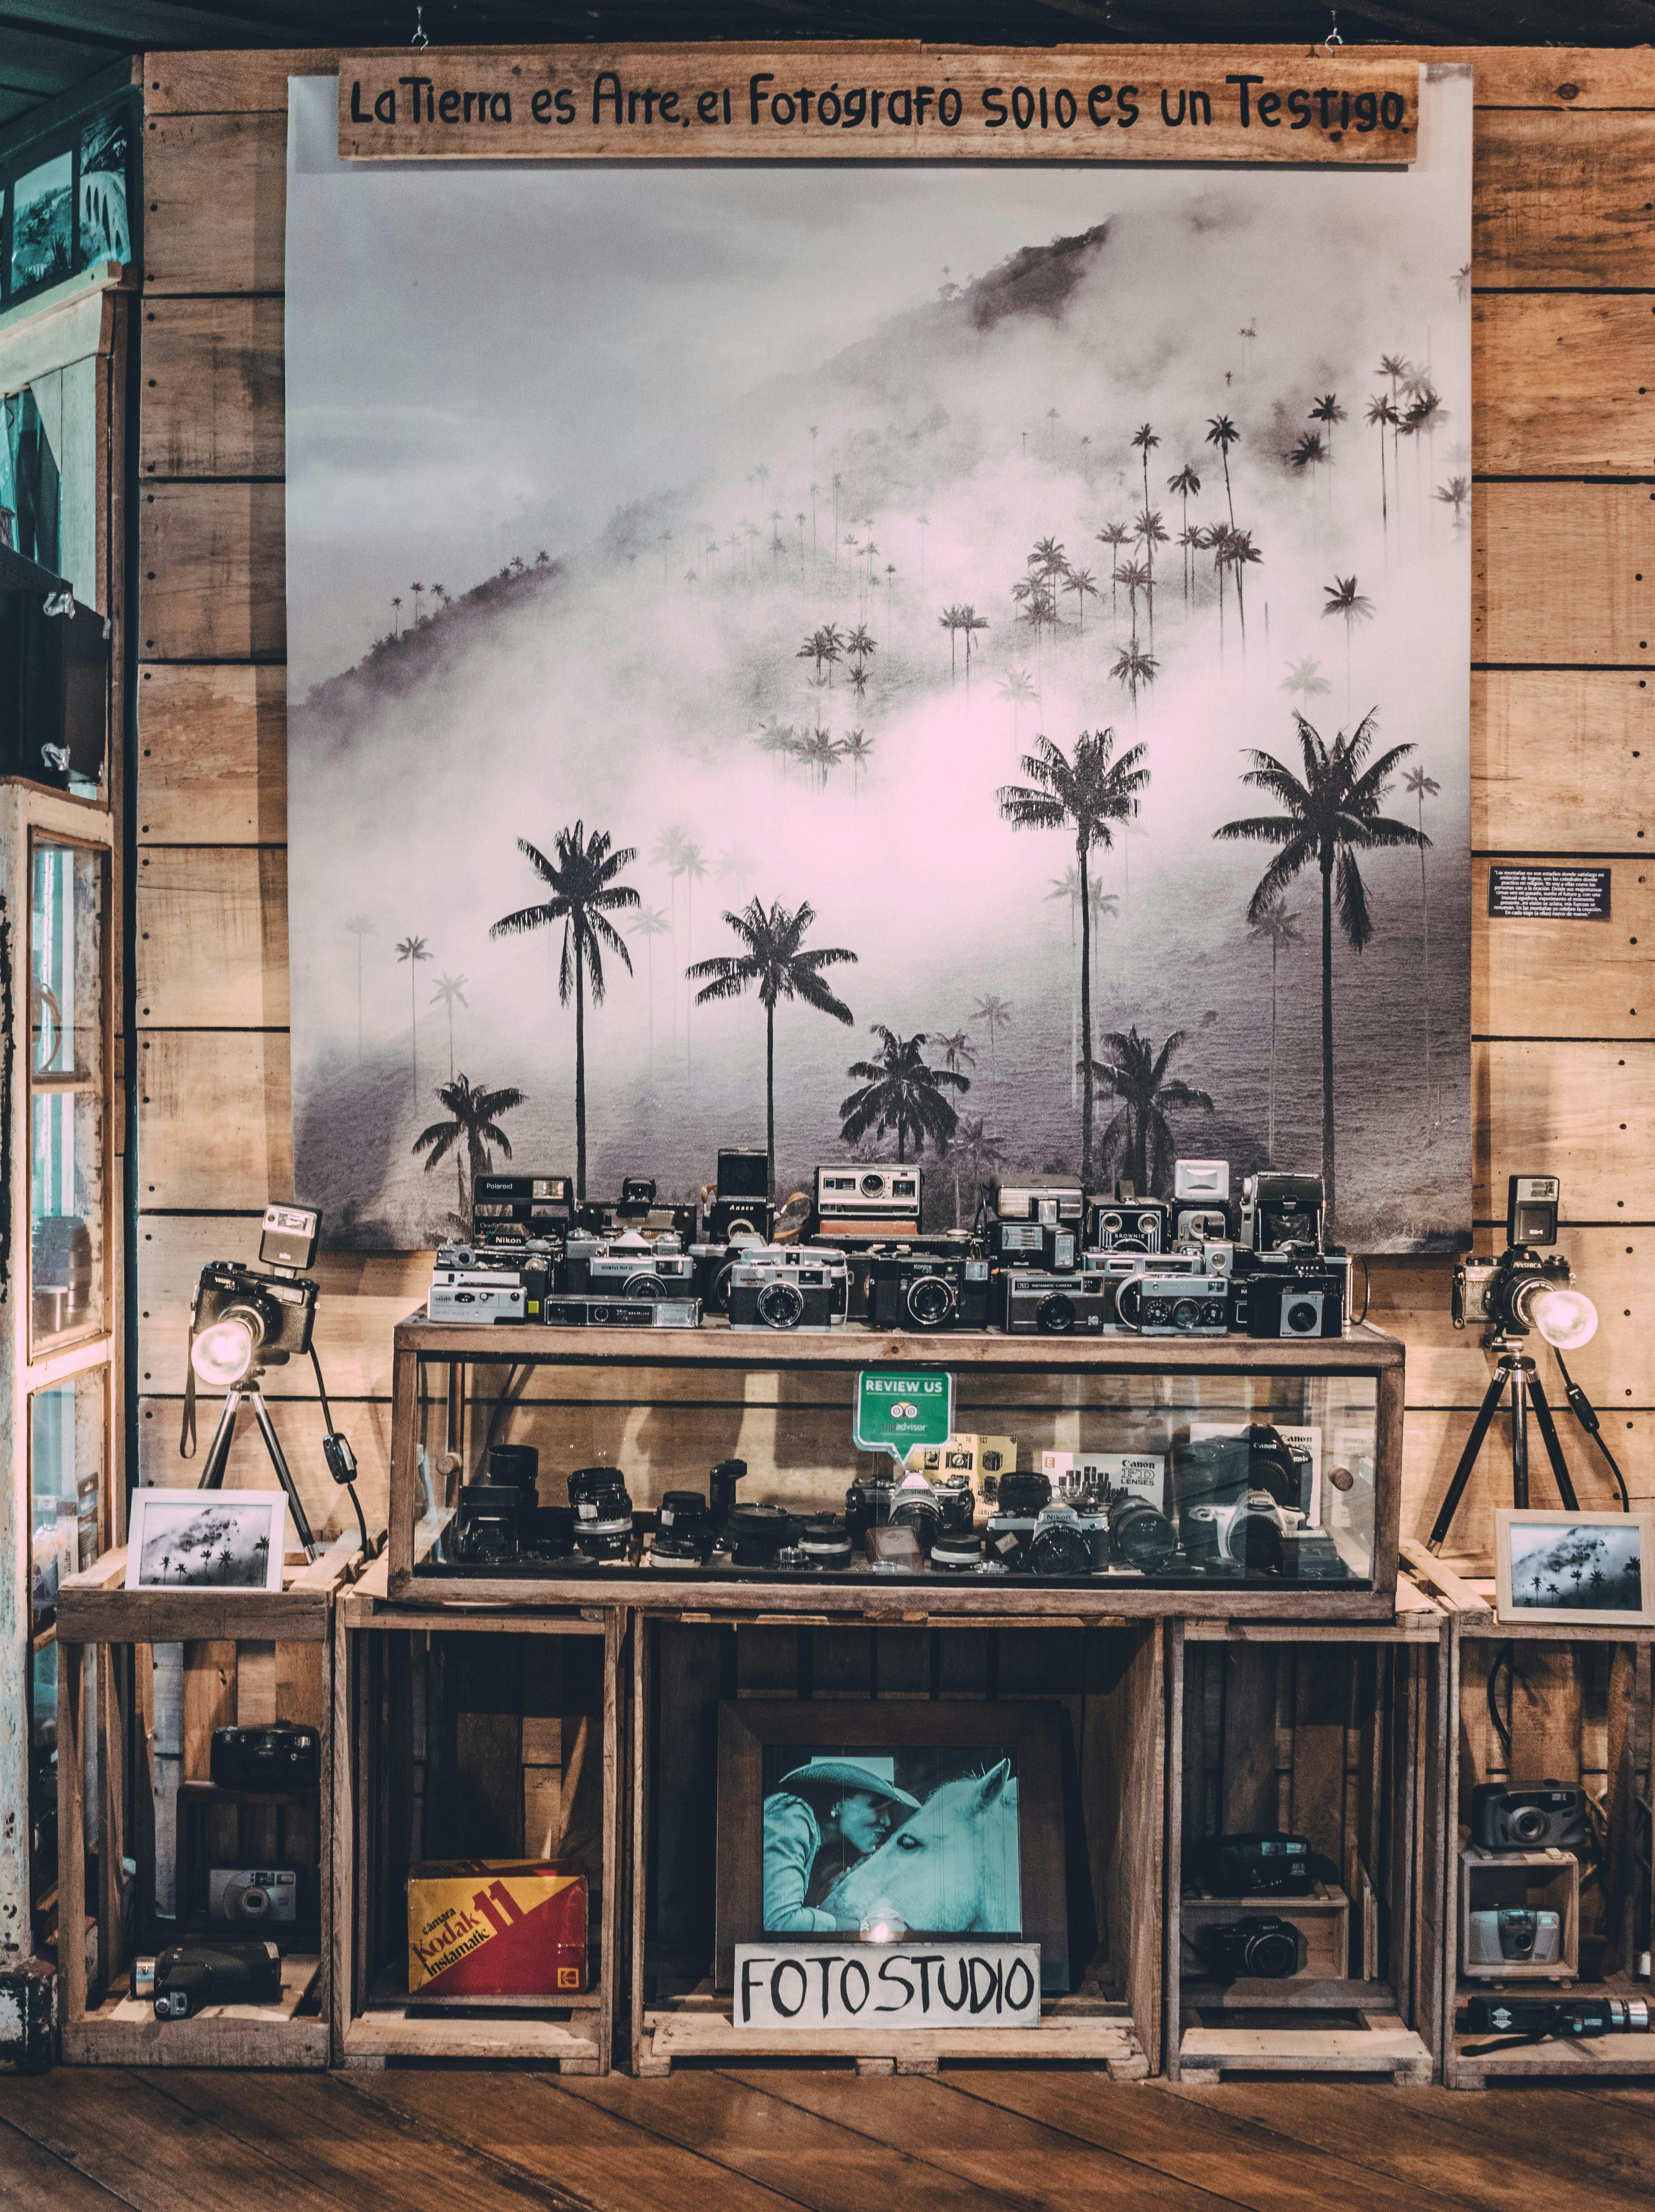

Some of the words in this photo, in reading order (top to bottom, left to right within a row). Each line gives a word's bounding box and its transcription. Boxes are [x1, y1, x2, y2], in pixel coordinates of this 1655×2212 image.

[351, 80, 395, 124] La
[398, 77, 511, 124] Tierra
[531, 87, 576, 125] es
[592, 72, 690, 127] Arte,
[698, 87, 731, 125] el
[1087, 85, 1139, 128] es
[1161, 88, 1212, 127] un
[1226, 74, 1409, 134] Testigo.
[214, 1276, 235, 1286] YASHICA
[866, 1380, 920, 1392] REVIEW
[924, 1382, 942, 1393] US
[882, 1422, 927, 1432] tripadvisor
[1281, 1434, 1312, 1443] Canon
[1122, 1459, 1155, 1469] Canon
[1121, 1468, 1155, 1480] FD
[472, 1879, 527, 1934] 11
[422, 1907, 456, 1935] cámara
[412, 1910, 481, 1963] Kodak
[423, 1928, 490, 1978] Instamatic
